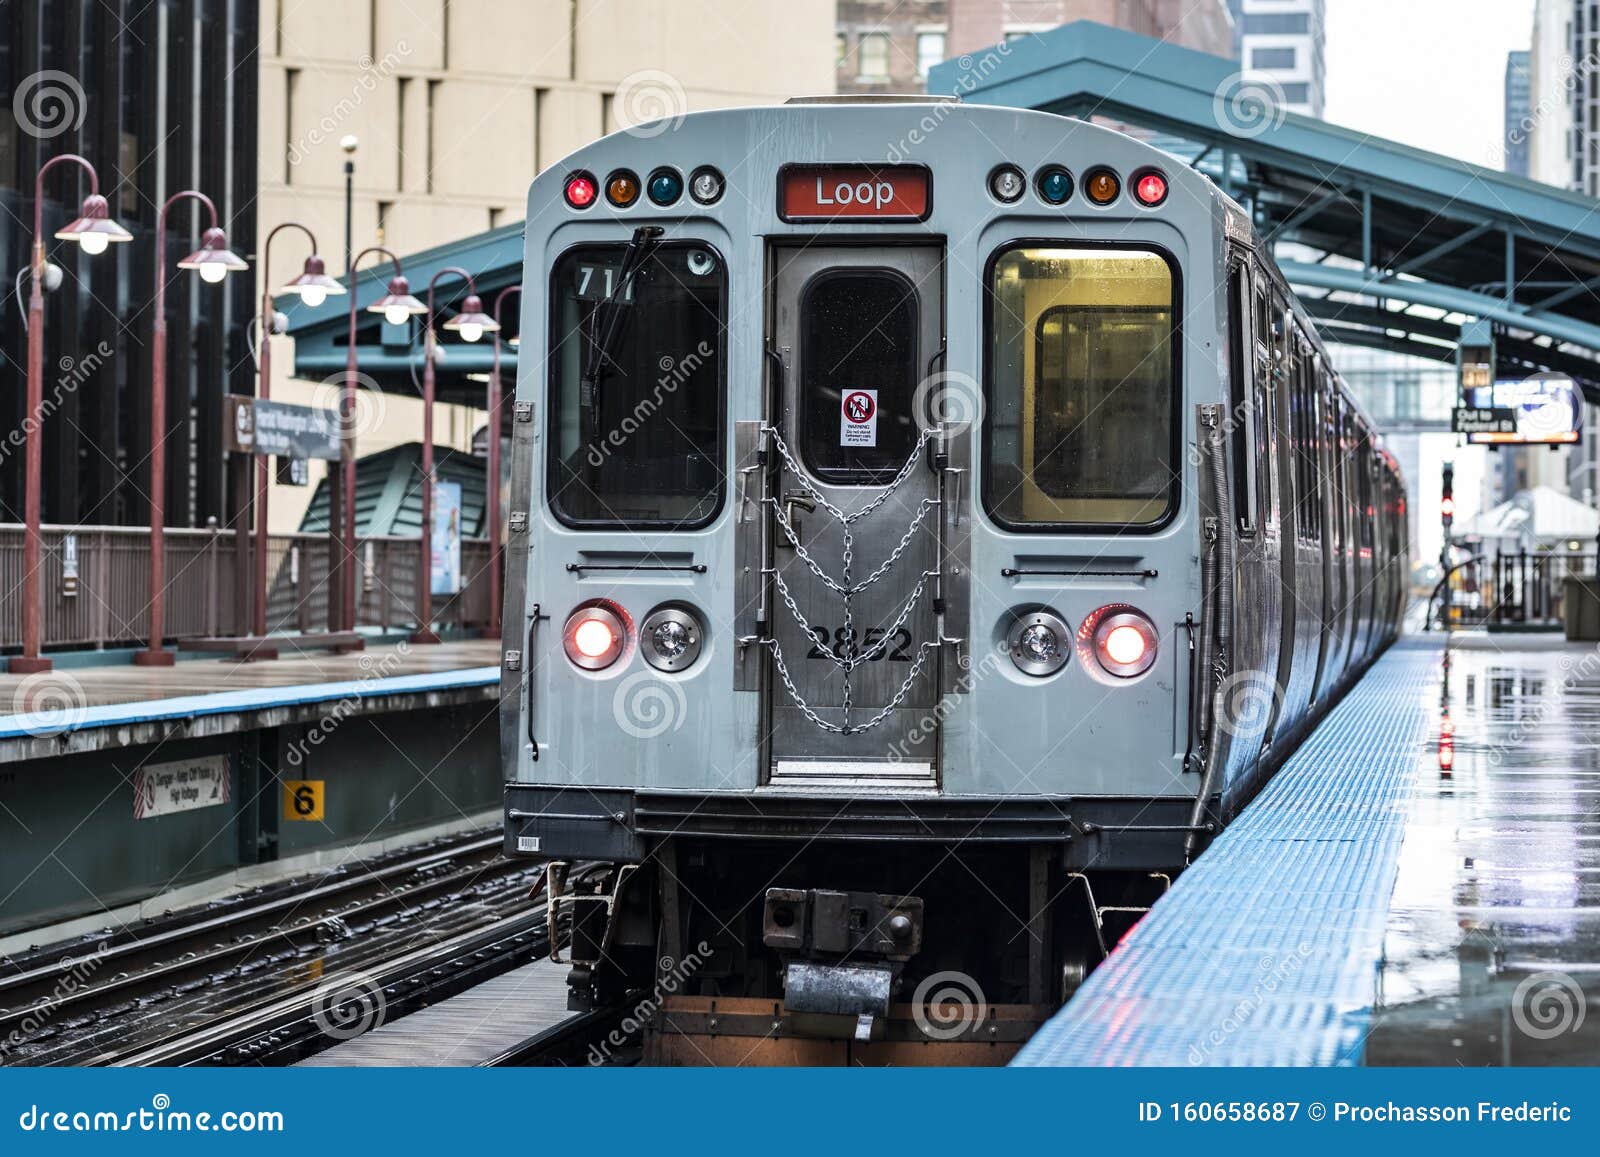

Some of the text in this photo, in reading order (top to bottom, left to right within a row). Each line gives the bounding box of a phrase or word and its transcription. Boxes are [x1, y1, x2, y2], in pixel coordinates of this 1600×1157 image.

[816, 177, 894, 209] Loop
[807, 626, 912, 662] 2852
[294, 785, 315, 815] 6
